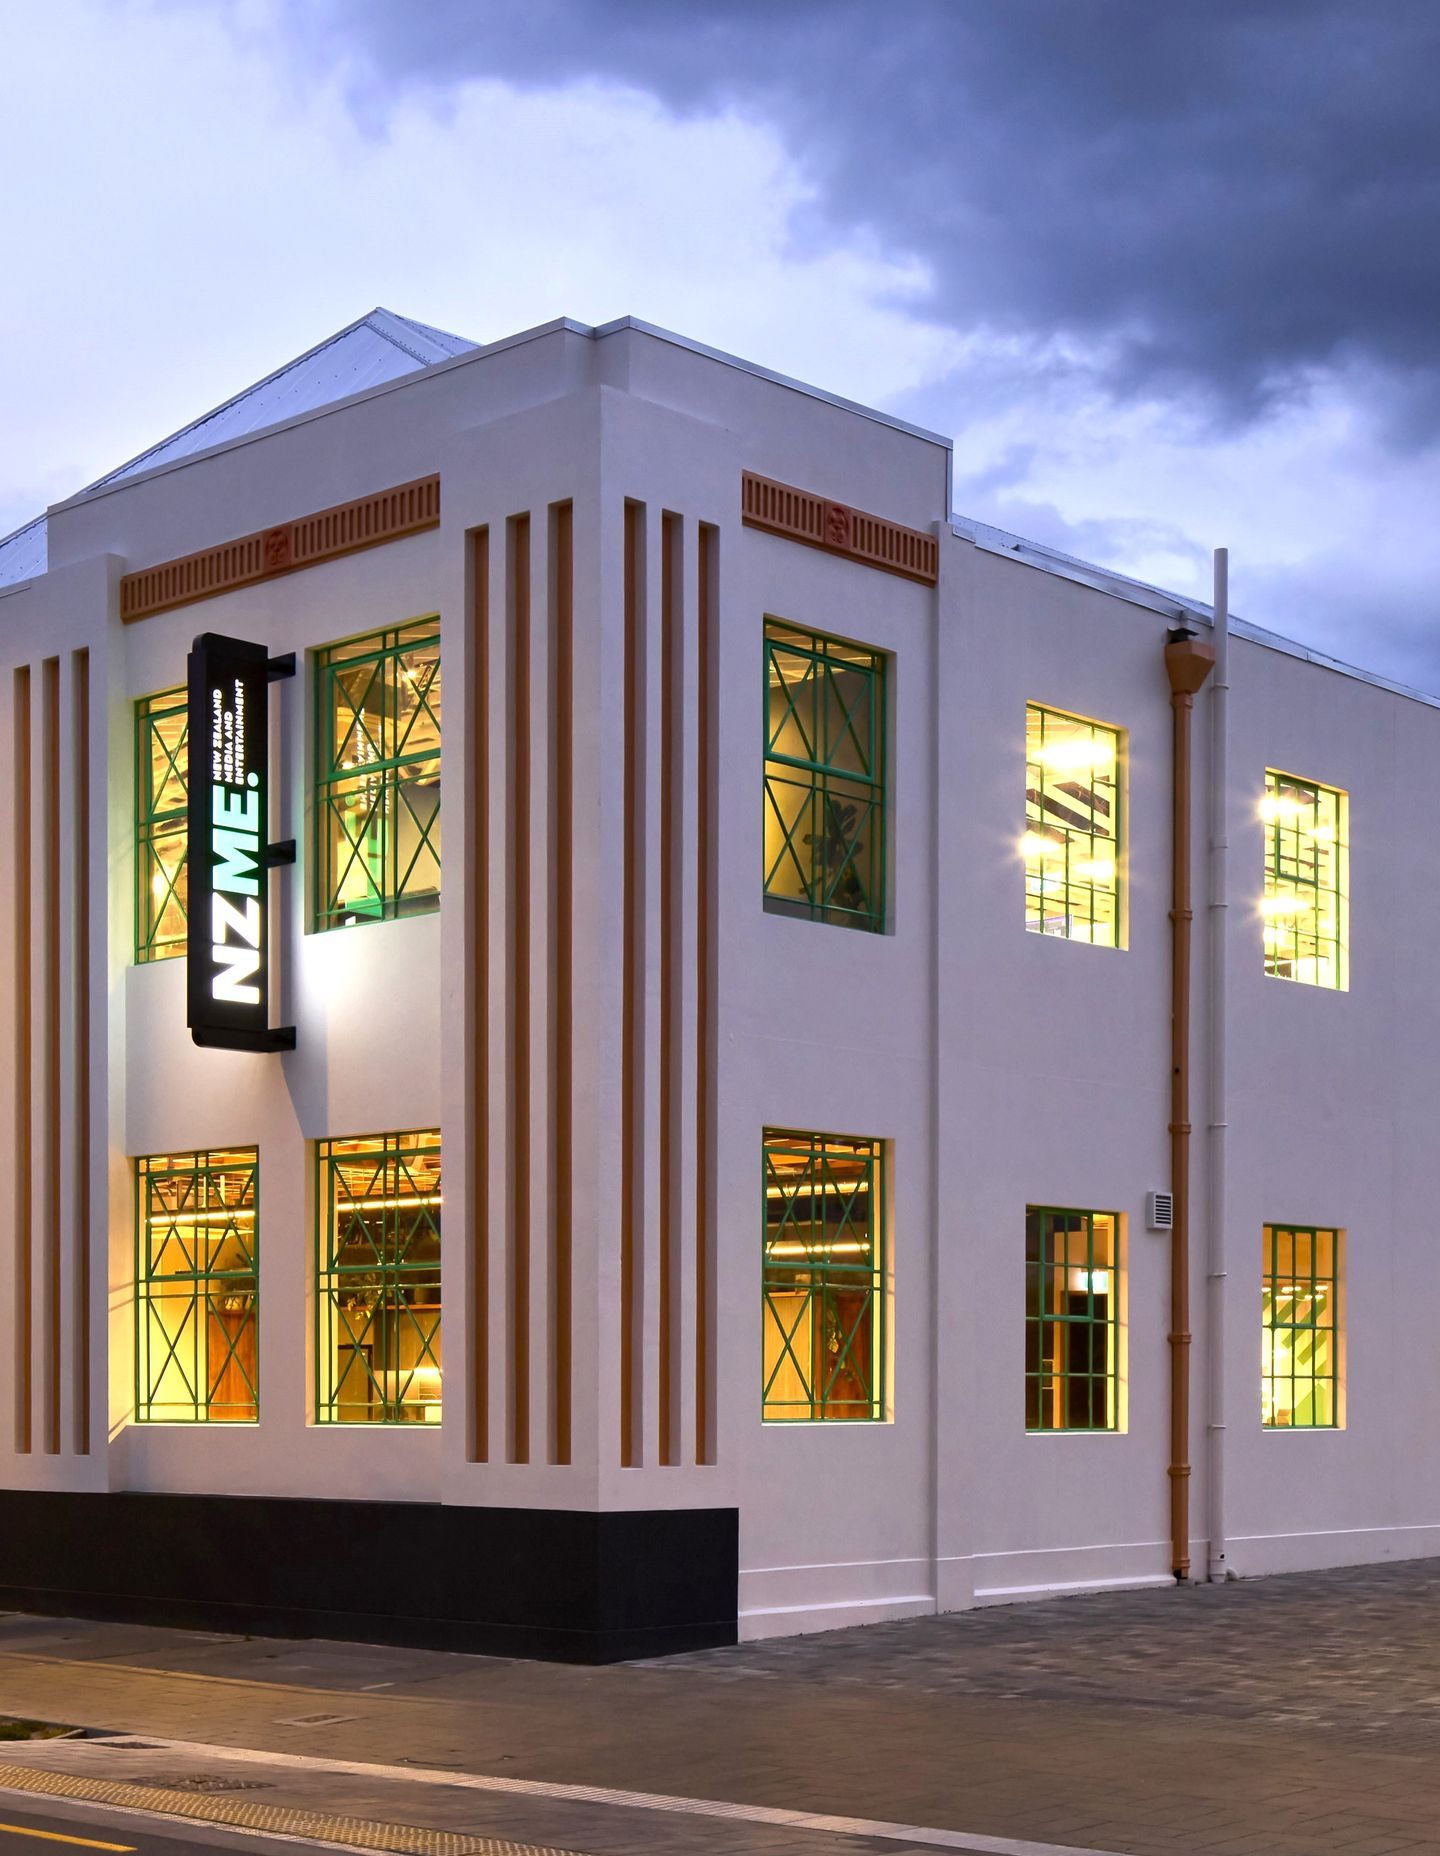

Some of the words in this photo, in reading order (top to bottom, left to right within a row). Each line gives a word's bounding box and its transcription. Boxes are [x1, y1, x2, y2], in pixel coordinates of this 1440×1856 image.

[213, 688, 223, 749] ZEALAND
[224, 710, 234, 740] AND
[235, 678, 245, 786] ENTERTAINMENT
[213, 750, 223, 781] NEW
[224, 741, 234, 783] MEDIA
[212, 772, 261, 1005] NZME.
